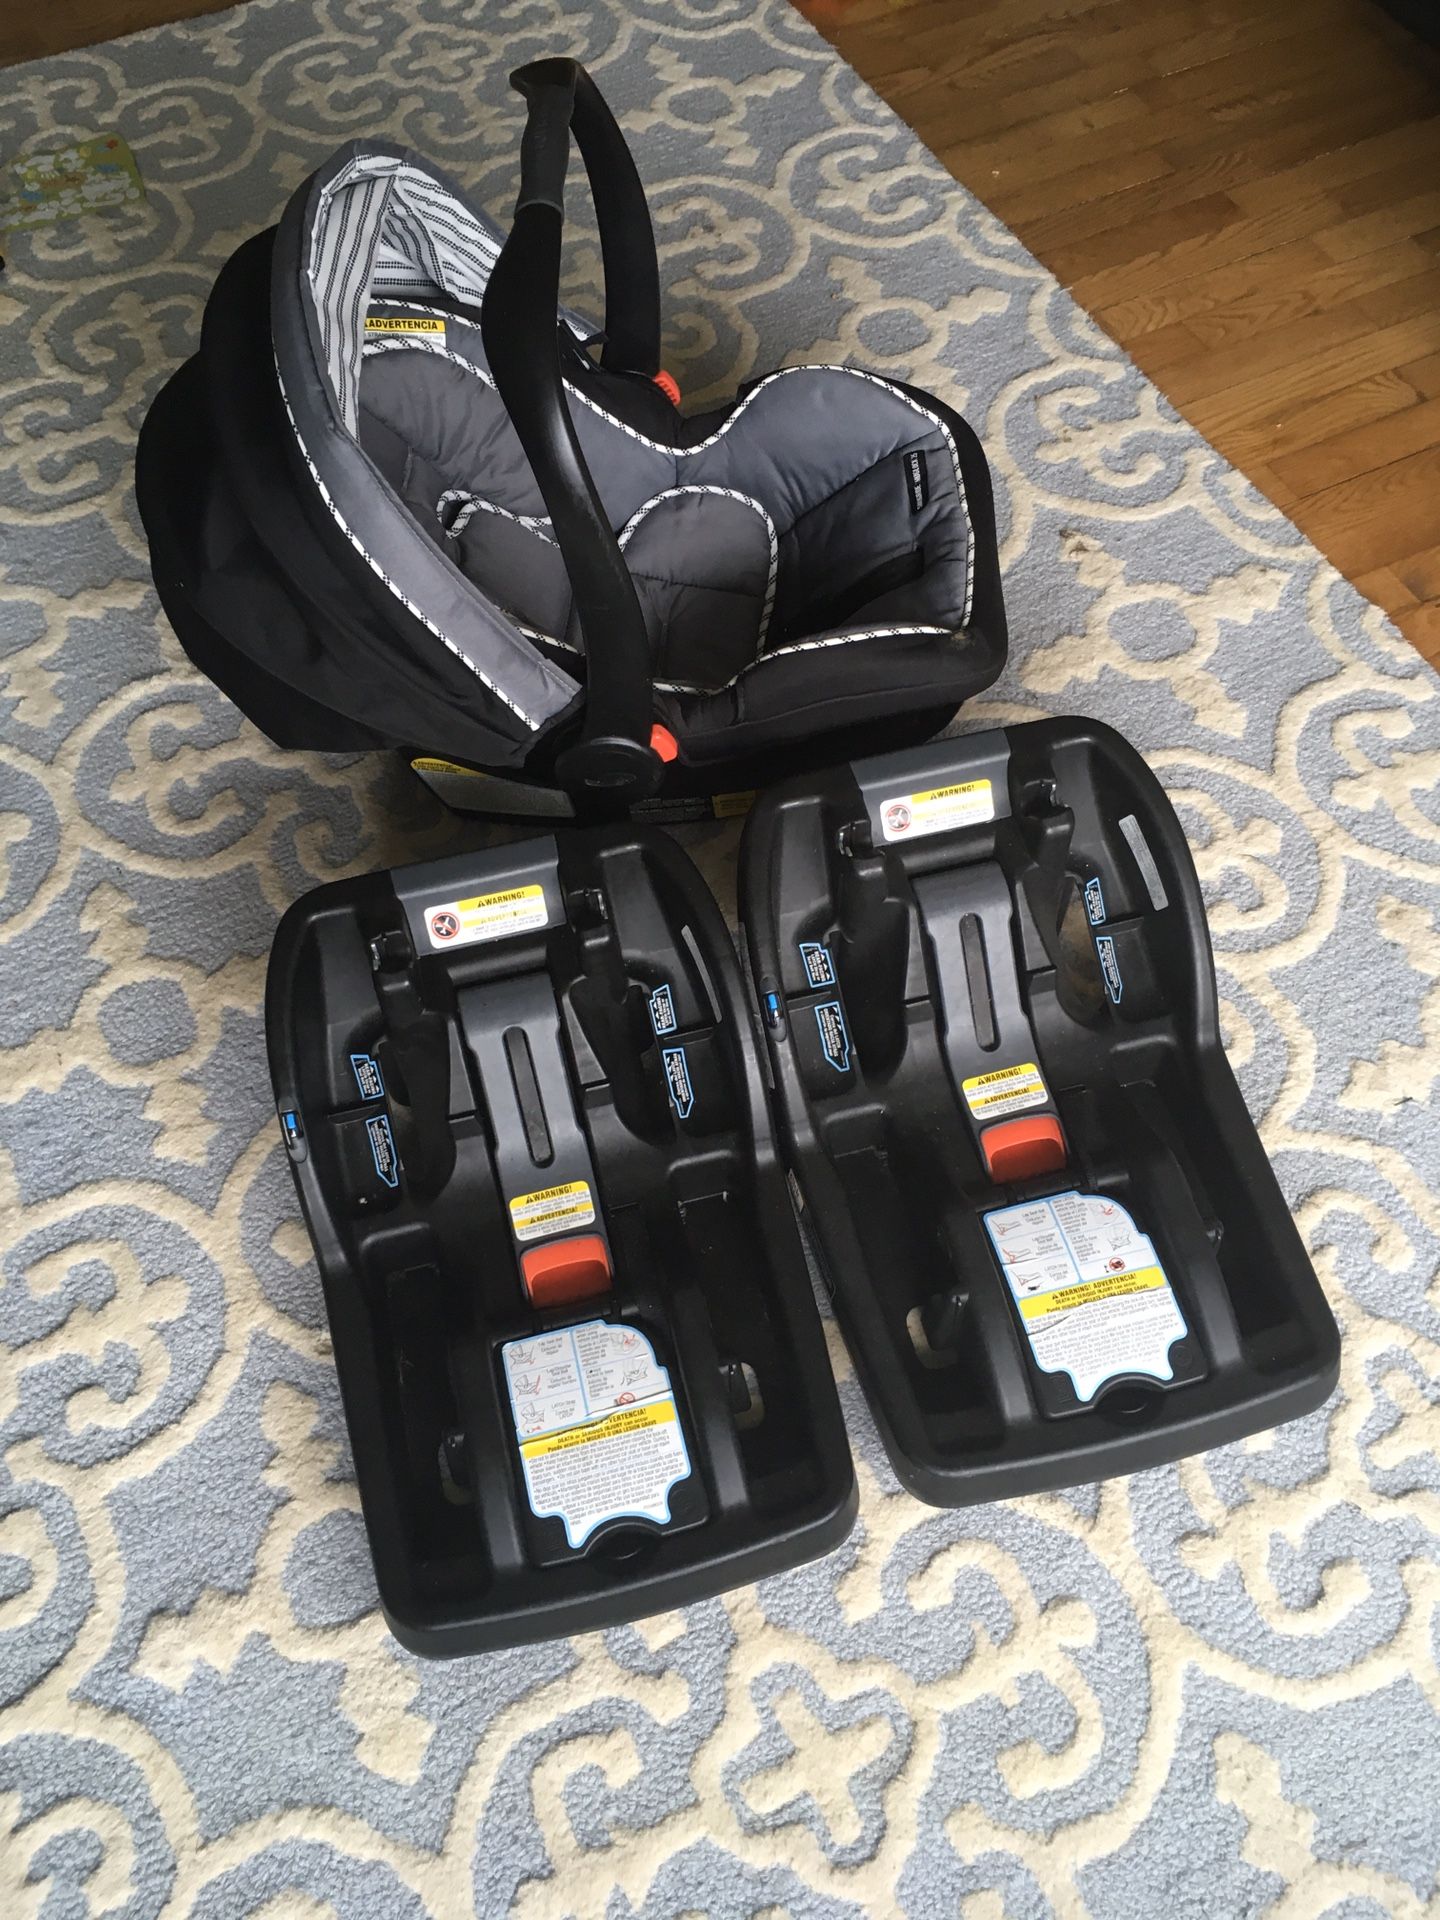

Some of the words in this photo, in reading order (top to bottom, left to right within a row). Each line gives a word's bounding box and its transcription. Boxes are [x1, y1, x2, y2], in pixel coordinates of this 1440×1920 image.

[369, 319, 438, 330] ADVERTENCIA
[936, 785, 976, 798] WARNING!
[485, 891, 525, 906] WARNING!
[984, 1068, 1022, 1083] WARNING!
[990, 1088, 1030, 1101] ADVERTENCIA!
[533, 1185, 572, 1201] WARNING!
[537, 1207, 578, 1221] ADVERTENCIA!
[1058, 1284, 1091, 1297] WARNING!
[1092, 1273, 1137, 1289] ADVERTENCIA!
